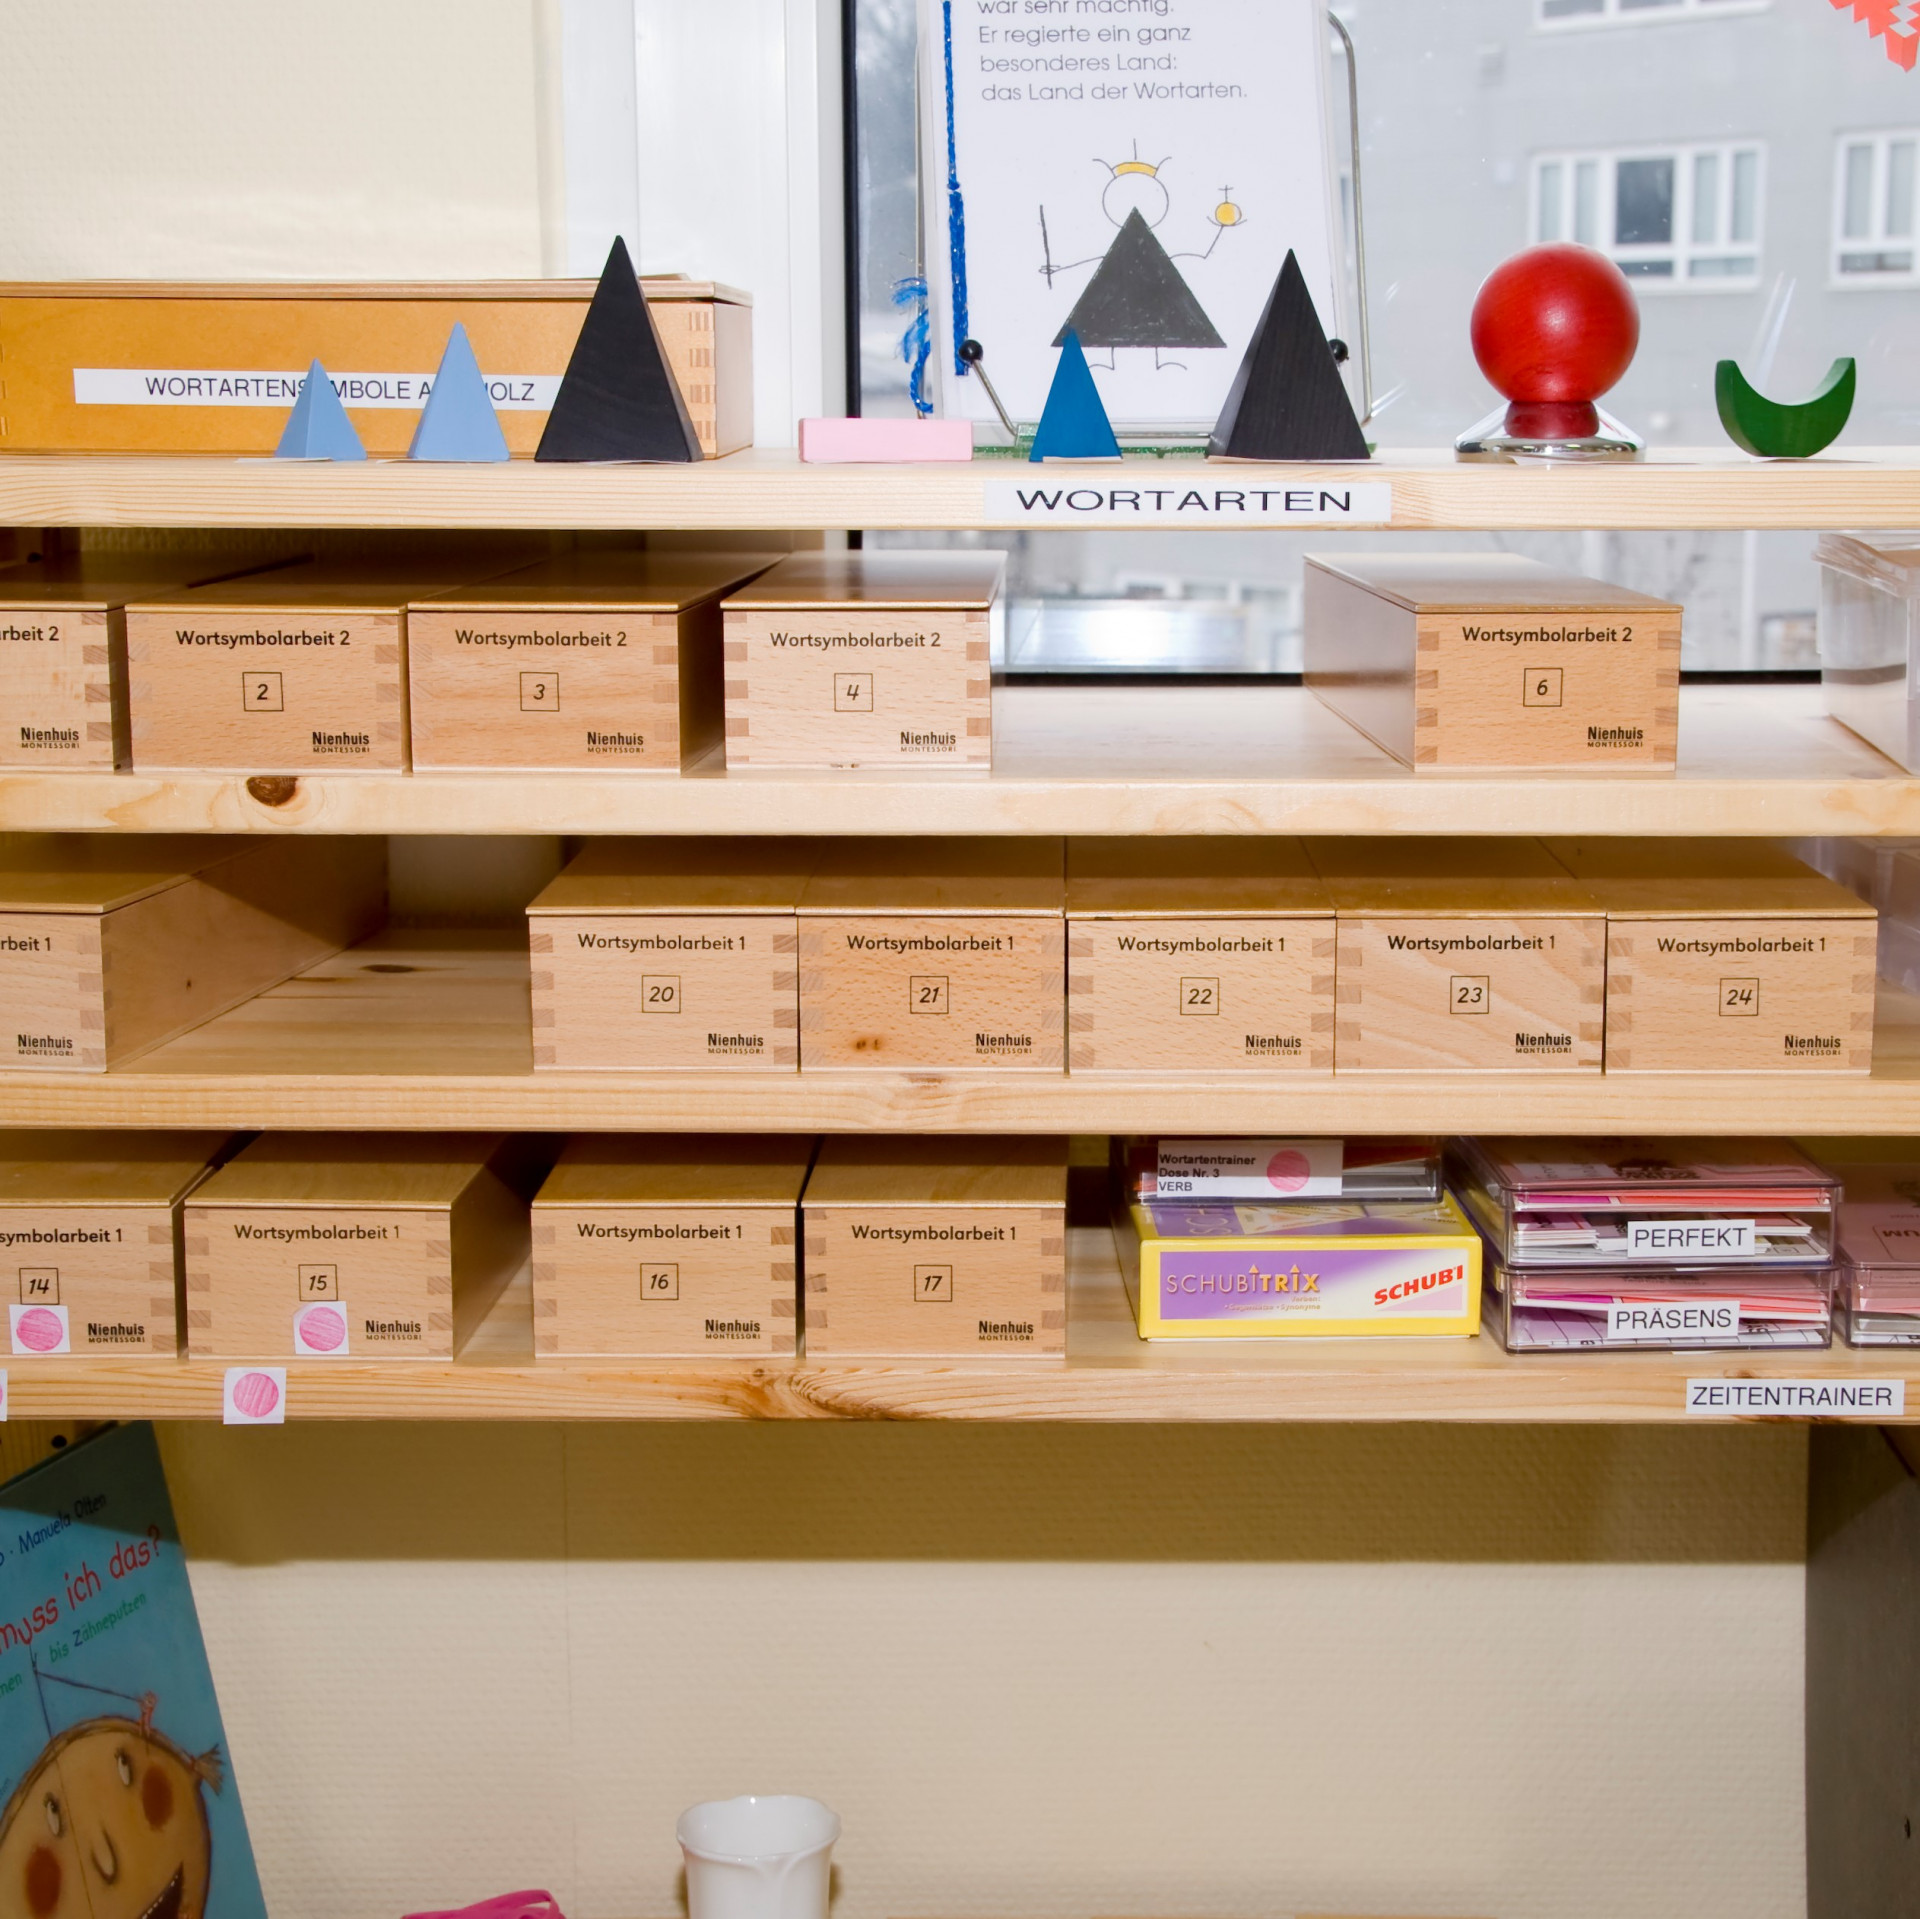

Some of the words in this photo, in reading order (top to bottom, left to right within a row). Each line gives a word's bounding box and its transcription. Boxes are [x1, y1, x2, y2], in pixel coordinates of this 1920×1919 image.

[977, 0, 1018, 14] war
[978, 25, 998, 44] Er
[1004, 24, 1091, 48] regierte
[1097, 24, 1131, 43] ein
[1136, 27, 1191, 46] ganz
[980, 54, 1110, 73] besonderes
[1116, 52, 1177, 71] Land:
[981, 83, 1022, 101] das
[1028, 82, 1084, 101] Land
[1090, 82, 1129, 100] der
[1133, 81, 1248, 100] Wortarten.
[484, 382, 535, 401] OLZ
[1016, 489, 1351, 512] WORTARTEN
[0, 625, 44, 642] rbeit
[48, 625, 60, 642] 2
[175, 629, 335, 650] Wortsymbolarbeit
[339, 629, 351, 646] 2
[454, 629, 612, 650] Wortsymbolarbeit
[616, 631, 628, 647] 2
[769, 631, 926, 652] Wortsymbolarbeit
[930, 631, 941, 648] 2
[1462, 626, 1618, 647] Wortsymbolarbeit
[1621, 626, 1633, 642] 2
[256, 683, 269, 701] 2
[532, 683, 546, 701] 3
[846, 684, 860, 701] 4
[1536, 678, 1548, 696] 6
[20, 726, 80, 743] Nienhuis
[312, 731, 370, 746] Nienhuis
[587, 731, 644, 746] Nienhuis
[900, 731, 956, 746] Nienhuis
[1587, 726, 1644, 741] Nienhuis
[312, 746, 370, 754] MONTESSORI
[587, 746, 644, 754] MONTESSORI
[900, 745, 957, 753] MONTESSORI
[1587, 740, 1643, 748] MONTESSORI
[44, 936, 51, 952] 1
[577, 933, 734, 954] Wortsymbolarbeit
[739, 935, 745, 951] 1
[846, 935, 1002, 955] Wortsymbolarbeit
[1007, 935, 1014, 951] 1
[1117, 936, 1274, 956] Wortsymbolarbeit
[1278, 937, 1285, 952] 1
[1387, 934, 1544, 955] Wortsymbolarbeit
[1549, 934, 1555, 950] 1
[1656, 936, 1815, 957] Wortsymbolarbeit
[1819, 936, 1826, 952] 1
[648, 985, 675, 1003] 20
[919, 986, 940, 1004] 21
[1187, 988, 1213, 1005] 22
[1457, 986, 1483, 1004] 23
[1726, 989, 1753, 1006] 24
[17, 1033, 73, 1049] Nienhuis
[707, 1033, 764, 1047] Nienhuis
[975, 1033, 1032, 1047] Nienhuis
[1245, 1034, 1302, 1049] Nienhuis
[1515, 1032, 1572, 1048] Nienhuis
[1784, 1034, 1841, 1049] Nienhuis
[17, 1049, 74, 1057] MONTESSORI
[707, 1047, 764, 1055] MONTESSORI
[975, 1047, 1032, 1056] MONTESSORI
[1245, 1048, 1302, 1056] MONTESSORI
[1784, 1049, 1841, 1057] MONTESSORI
[1158, 1153, 1256, 1165] Wortartentrainer
[1158, 1168, 1189, 1178] Dose
[1192, 1168, 1209, 1178] Nr.
[1212, 1168, 1220, 1178] 3
[1158, 1181, 1193, 1192] VERB
[115, 1227, 122, 1243] 1
[233, 1224, 387, 1244] Wortsymbolarbeit
[393, 1224, 399, 1239] 1
[577, 1223, 731, 1243] Wortsymbolarbeit
[735, 1224, 742, 1239] 1
[851, 1224, 1005, 1244] Wortsymbolarbeit
[1009, 1226, 1016, 1241] 1
[1634, 1227, 1748, 1248] PERFEKT
[29, 1278, 50, 1295] 14
[309, 1274, 328, 1291] 15
[650, 1273, 669, 1290] 16
[924, 1275, 943, 1292] 17
[1166, 1264, 1320, 1293] SCHUBITRIX
[1374, 1265, 1464, 1305] SCHUBI
[365, 1319, 422, 1333] Nienhuis
[705, 1319, 761, 1333] Nienhuis
[1616, 1305, 1732, 1330] PRÄSENS
[87, 1322, 145, 1337] Nienhuis
[978, 1320, 1034, 1334] Nienhuis
[88, 1336, 146, 1344] MONTESSORI
[365, 1333, 422, 1341] MONTESSORI
[705, 1332, 761, 1340] MONTESSORI
[1692, 1386, 1892, 1406] ZEITENTRAINER
[18, 1510, 72, 1554] Manuela
[64, 1561, 101, 1611] ich
[109, 1524, 161, 1579] das?
[49, 1642, 70, 1663] bis
[72, 1592, 147, 1648] Zähneputzen
